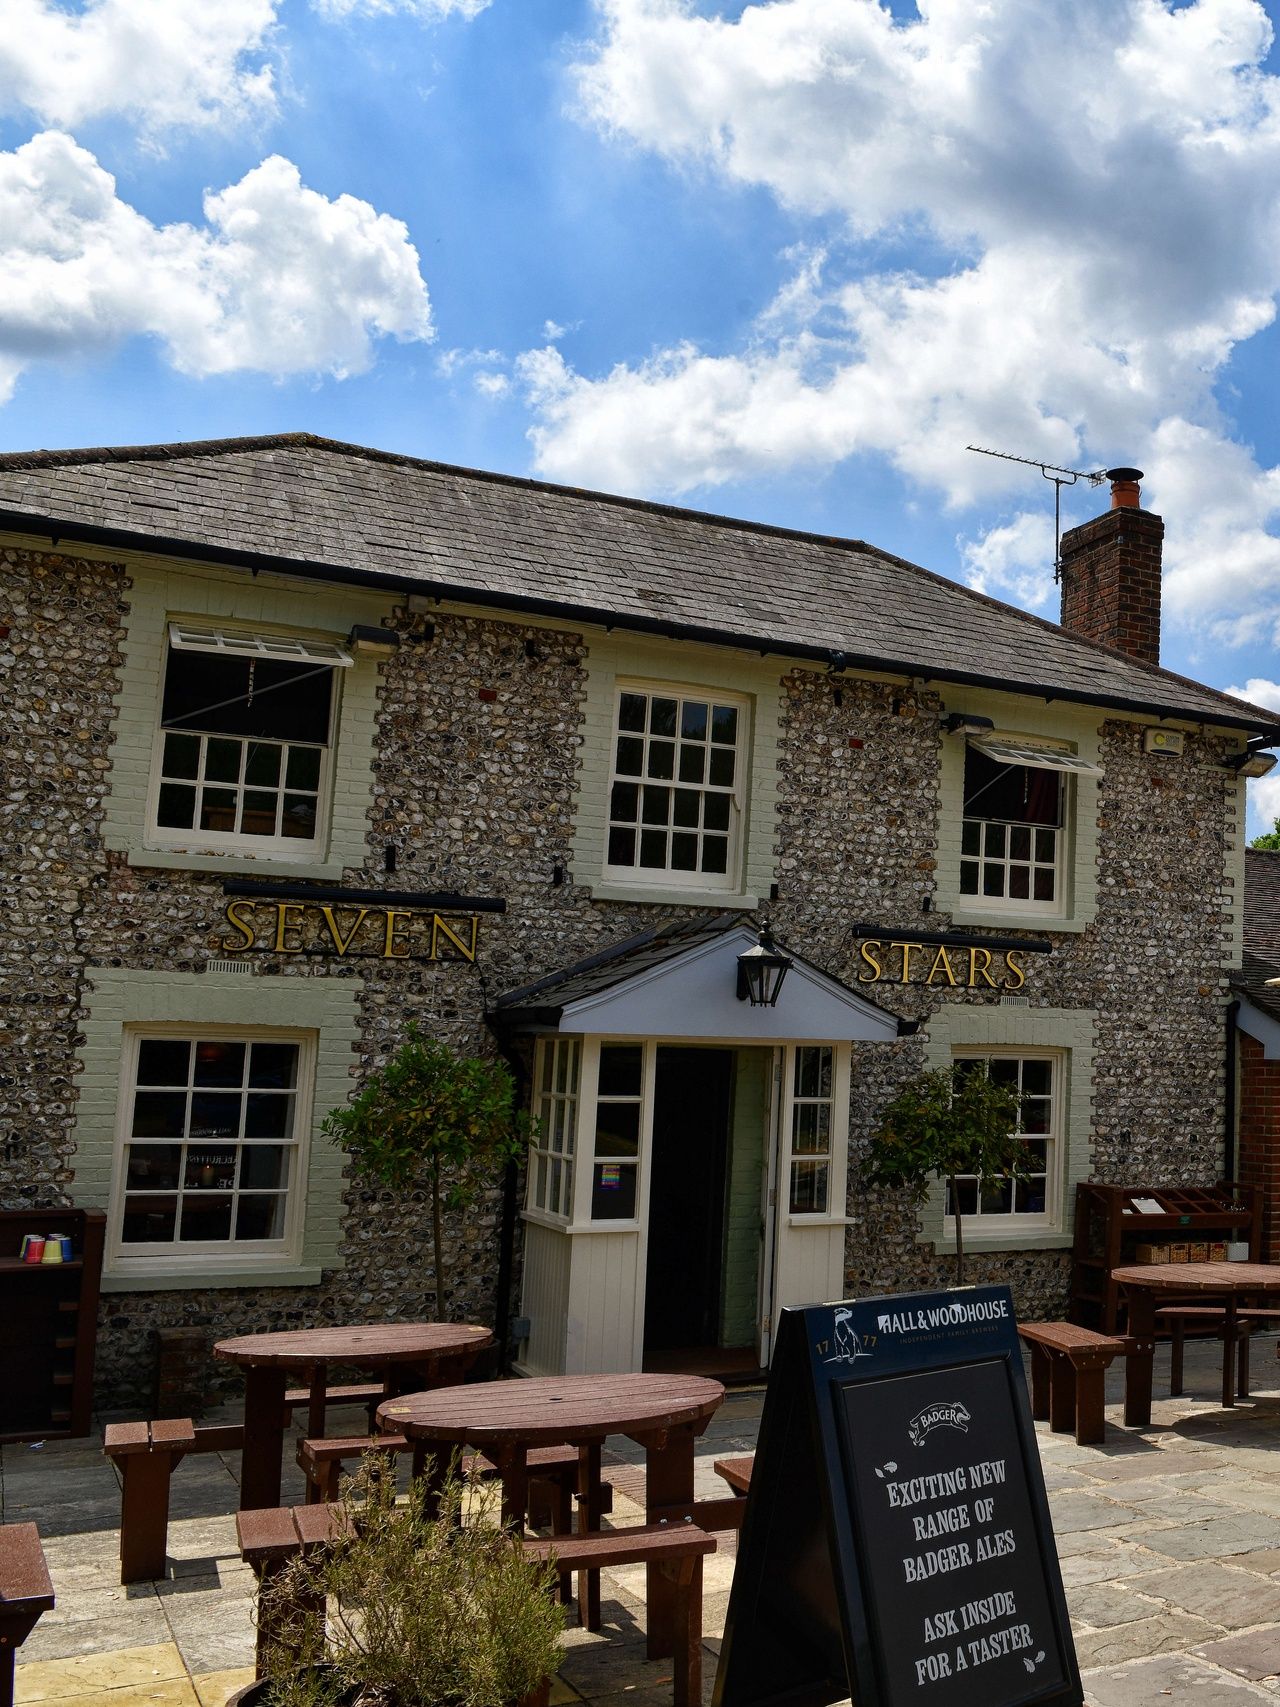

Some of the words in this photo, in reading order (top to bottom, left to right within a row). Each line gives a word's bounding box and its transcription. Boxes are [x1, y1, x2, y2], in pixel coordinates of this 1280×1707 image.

[222, 900, 482, 963] SEVEN
[858, 941, 1025, 989] STARS
[815, 1340, 829, 1355] 17
[862, 1335, 877, 1347] 77
[899, 1332, 945, 1344] INDEPENDENT
[947, 1329, 969, 1338] FAMILY
[920, 1409, 959, 1428] BADGER
[886, 1467, 967, 1508] EXCITING
[968, 1459, 1006, 1489] NEW
[912, 1504, 971, 1541] RANGE
[974, 1497, 995, 1523] OF
[902, 1542, 973, 1583] BADGER
[976, 1529, 1016, 1562] ALES
[924, 1610, 960, 1644] ASK
[960, 1590, 1017, 1631] INSIDE
[914, 1652, 953, 1686] FOR
[956, 1646, 969, 1672] A
[968, 1623, 1034, 1666] TASTER
